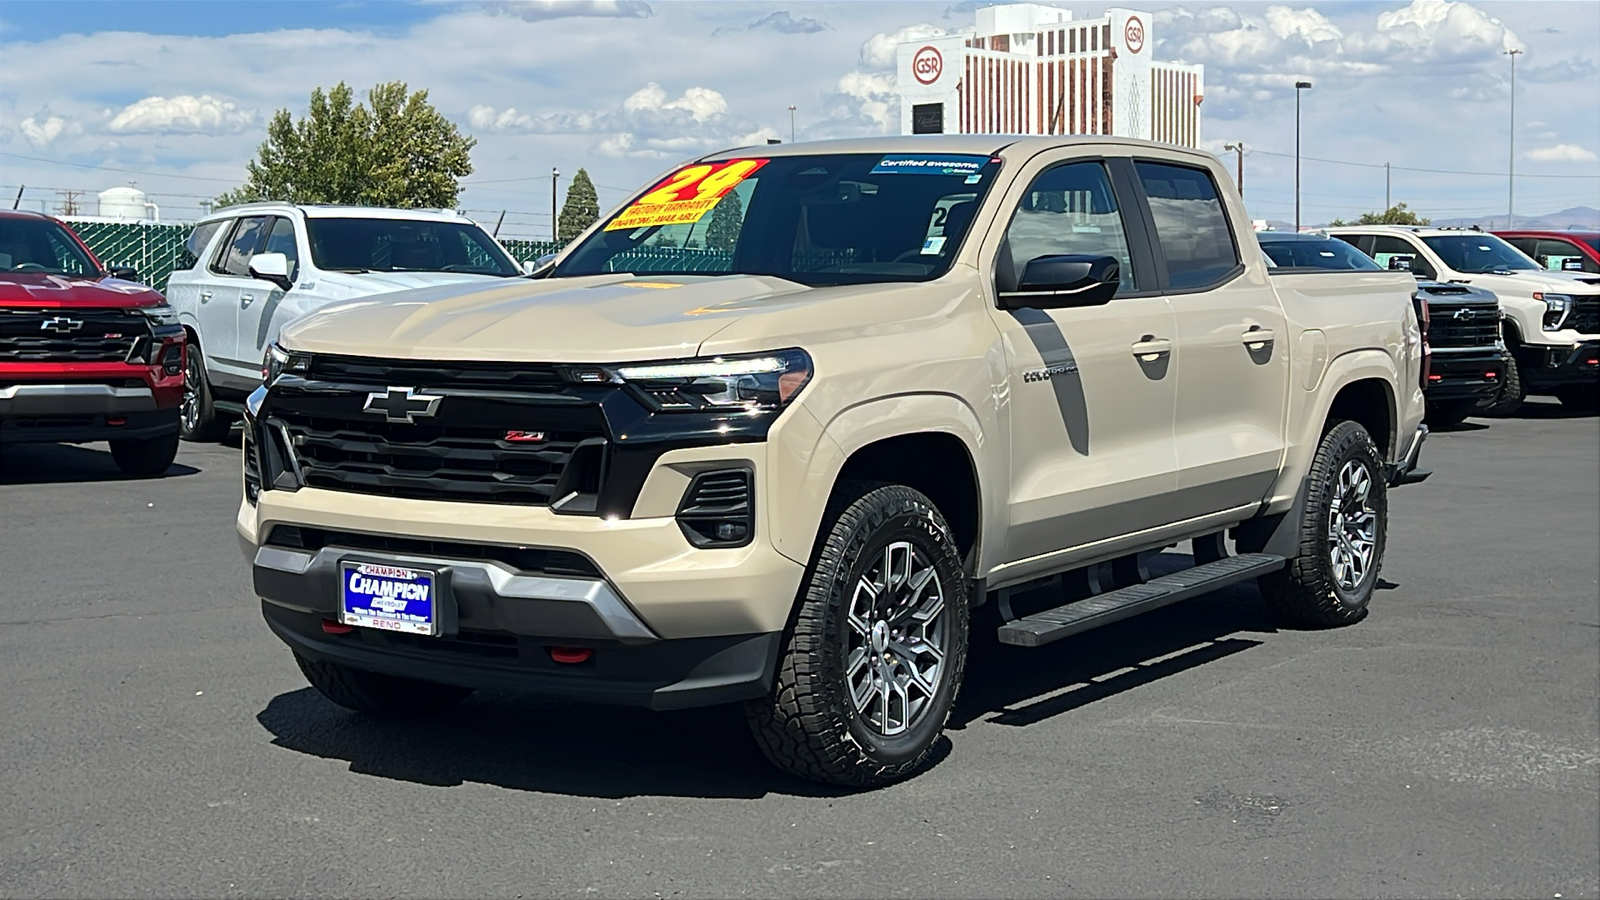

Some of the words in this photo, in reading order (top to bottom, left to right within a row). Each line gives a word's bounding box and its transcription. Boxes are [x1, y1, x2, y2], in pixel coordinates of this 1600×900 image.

[1127, 26, 1142, 43] GSR
[916, 57, 938, 74] GSR
[927, 161, 979, 169] awesome.
[637, 159, 759, 204] 24
[626, 203, 664, 216] FACTORY
[663, 199, 714, 212] WARRANTY
[609, 215, 654, 228] FINANCING
[652, 211, 702, 223] AVAILABLE
[504, 430, 545, 441] Z71
[365, 566, 408, 578] CHAMPION
[349, 573, 429, 601] CHAMPION
[373, 599, 404, 608] CHEVROLET
[372, 619, 401, 629] RENO
